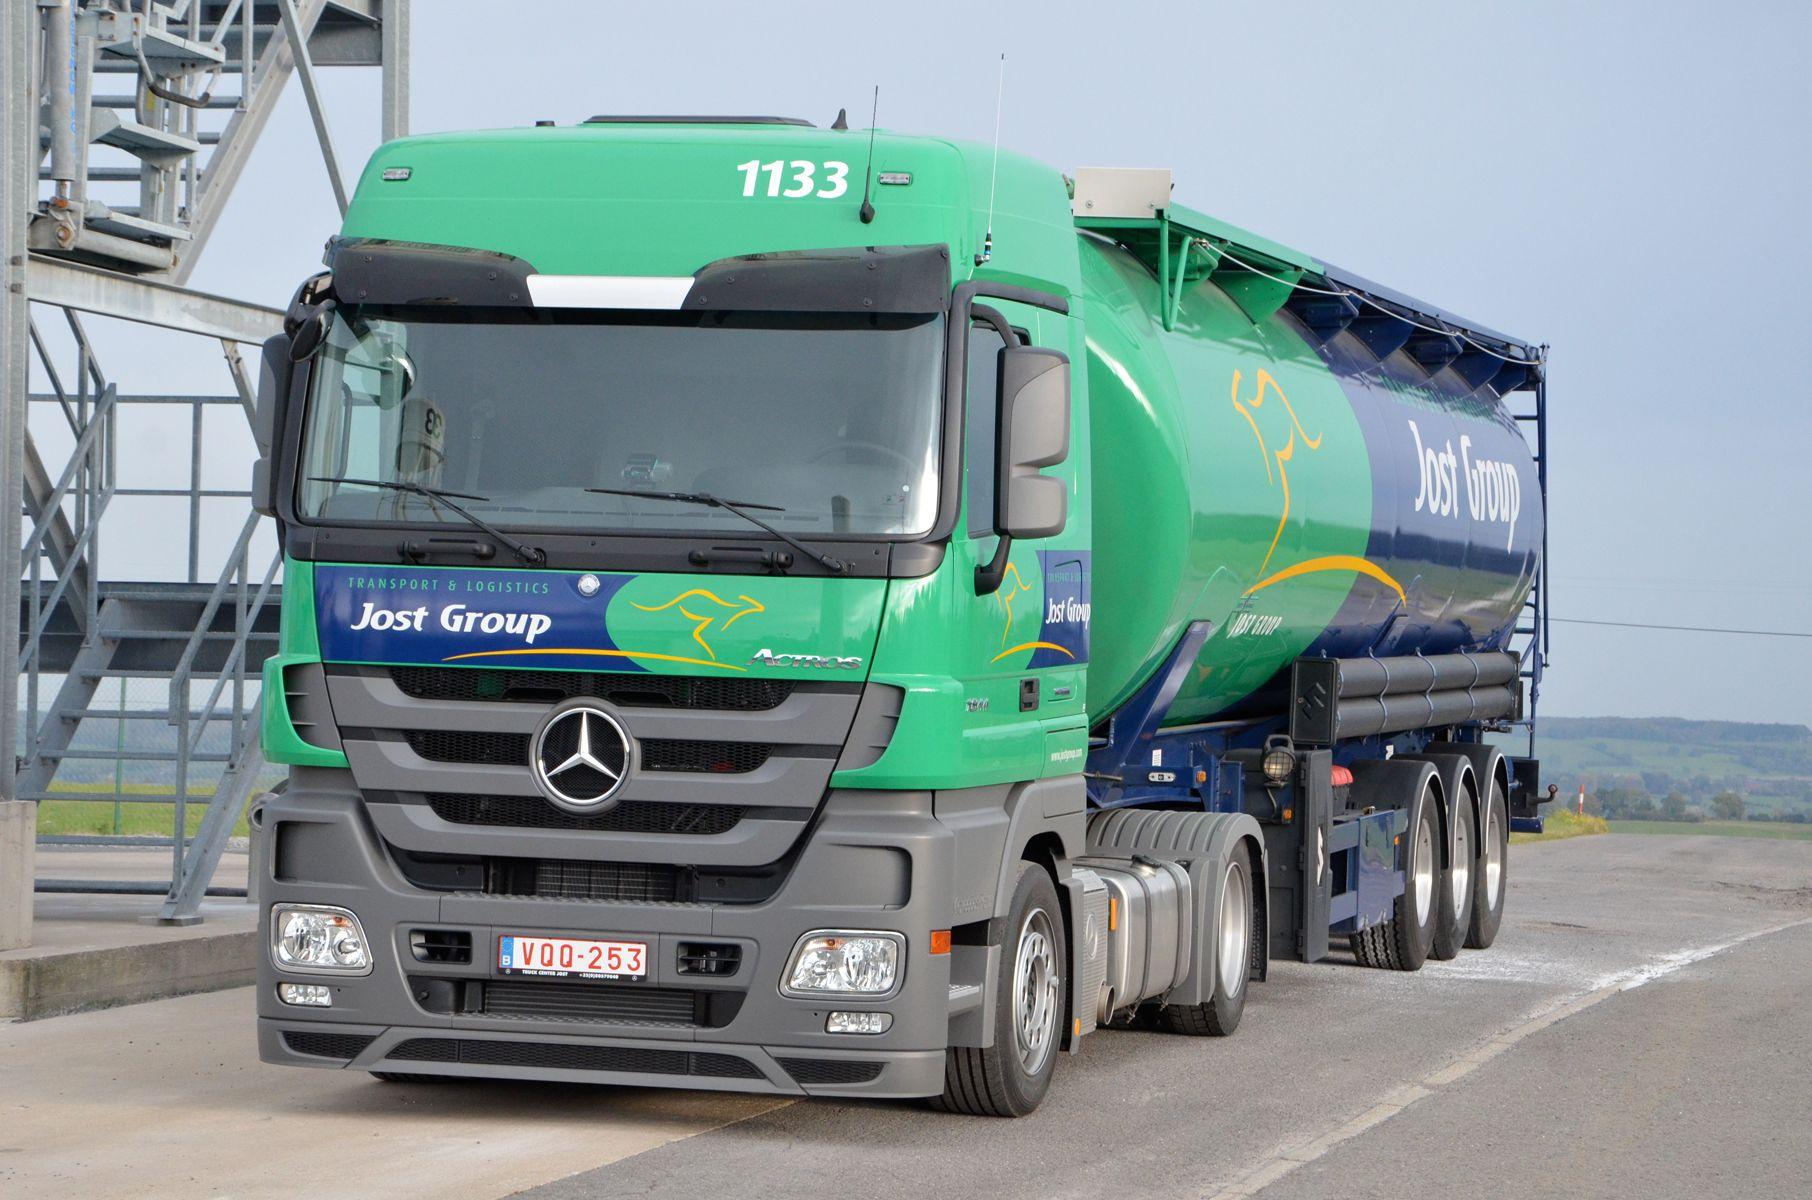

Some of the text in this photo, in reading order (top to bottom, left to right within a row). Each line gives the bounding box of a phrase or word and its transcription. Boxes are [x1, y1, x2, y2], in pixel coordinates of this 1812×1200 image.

[737, 159, 849, 199] 1133
[1408, 419, 1520, 555] Jost Group
[348, 577, 549, 594] TRANSPORT & LOGISTICS
[350, 602, 552, 645] Jost Group
[1045, 596, 1091, 630] Jost Group
[502, 955, 511, 966] B
[522, 942, 641, 970] VQQ-253
